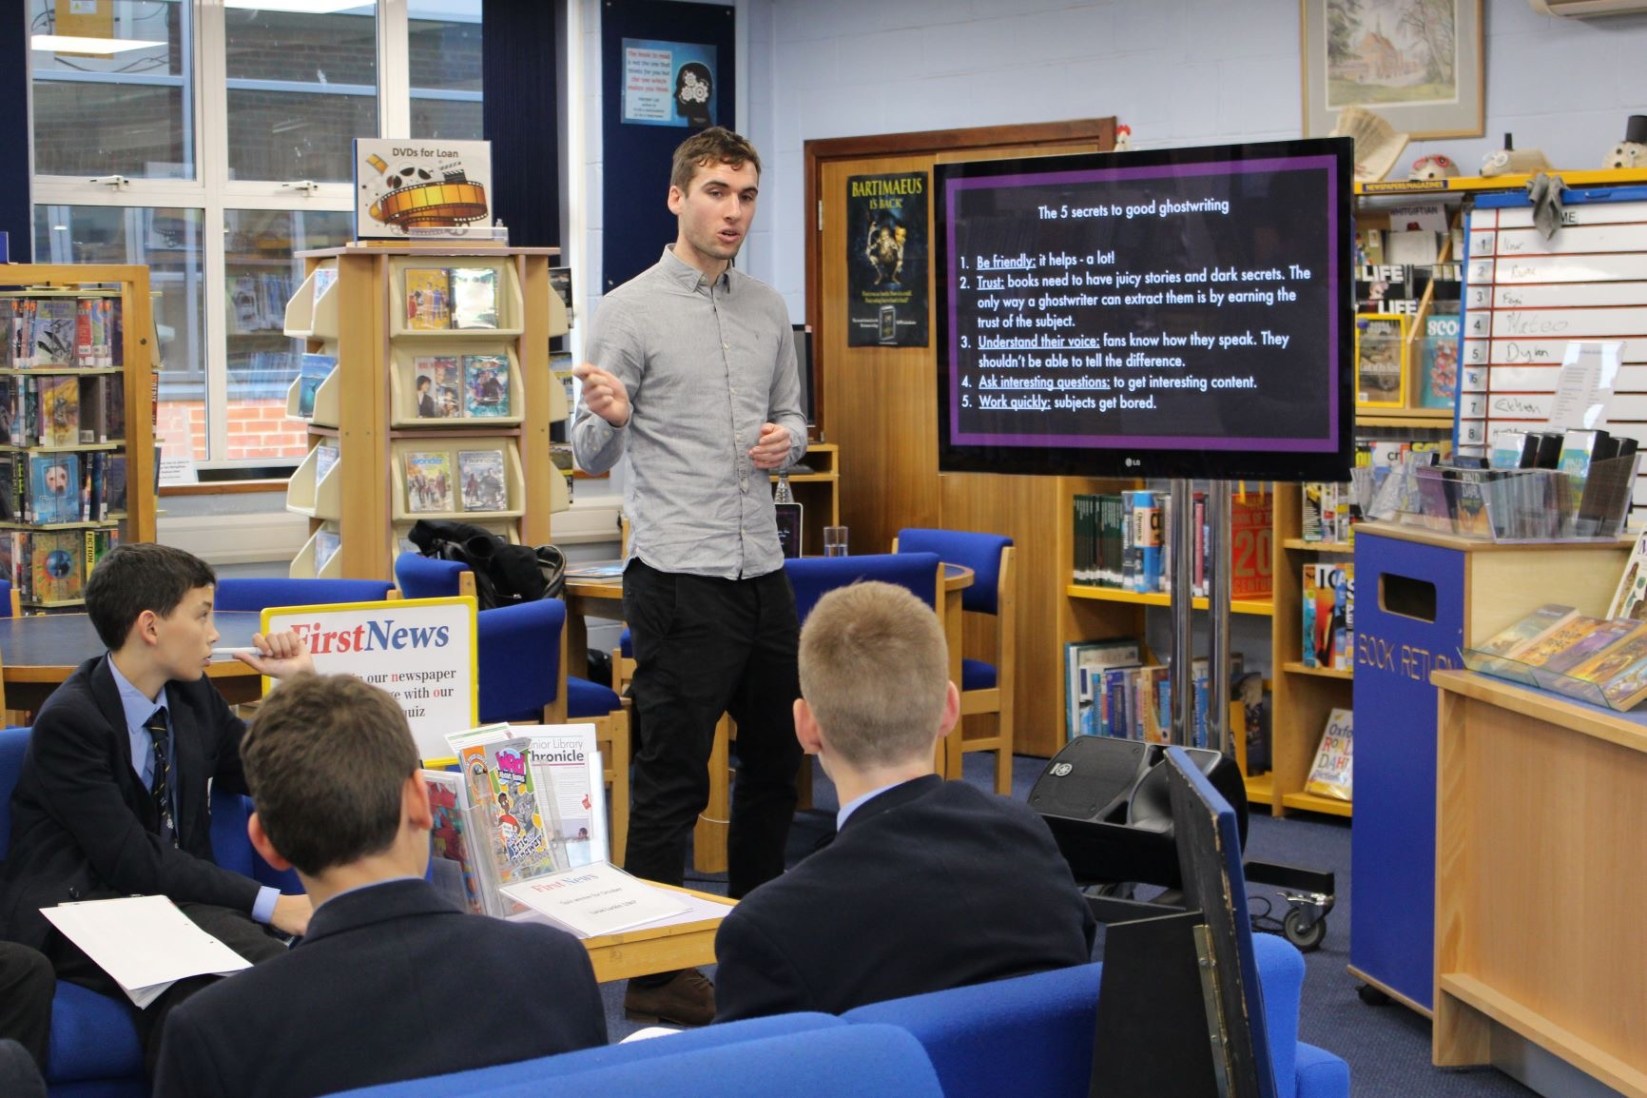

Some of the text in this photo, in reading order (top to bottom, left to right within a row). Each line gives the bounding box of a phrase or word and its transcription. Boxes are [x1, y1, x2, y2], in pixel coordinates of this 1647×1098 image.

[392, 148, 459, 158] DVDs for Loan
[852, 178, 922, 197] BARTIMAEUS
[869, 199, 878, 210] IS
[1038, 198, 1230, 219] The 5 secrets to good ghostwriting
[1560, 211, 1577, 223] ME
[1480, 239, 1487, 250] 1
[960, 256, 970, 269] 1.
[977, 255, 990, 270] Be
[992, 252, 1036, 270] friendly:
[1039, 253, 1046, 266] it
[1049, 252, 1077, 269] helps
[1087, 254, 1094, 265] a
[1097, 250, 1115, 264] lot!
[960, 264, 1311, 290] 2. Trust: books need to have juicy stories and dark secrets. The
[1362, 265, 1404, 281] LIFE
[1478, 266, 1486, 277] 2
[977, 286, 1297, 311] only way a ghostwriter can extract them is by earning the
[1476, 291, 1484, 303] 3
[1378, 300, 1418, 314] LIFE
[977, 313, 1076, 331] trust of the subject.
[1427, 320, 1460, 336] SCO
[1474, 320, 1481, 331] 4
[960, 330, 1290, 350] 3. Understand their voice: fans know how they speak. They
[978, 352, 1186, 368] shouldn't be able to tell the difference.
[1472, 350, 1479, 360] 5
[961, 374, 1257, 392] 4. Ask interesting questions: to get interesting content.
[1471, 373, 1479, 384] 6
[962, 394, 1157, 412] 5. Work quickly: subjects get bored.
[1471, 402, 1477, 413] 7
[1468, 428, 1476, 440] 8
[1359, 633, 1395, 672] BOOK
[367, 673, 388, 684] our
[391, 669, 457, 684] newspaper
[404, 687, 430, 700] with
[433, 688, 454, 699] our
[1329, 724, 1353, 738] Oxfo
[531, 738, 583, 751] nior Library
[1322, 736, 1352, 756] ROAL
[531, 750, 585, 763] hronicle
